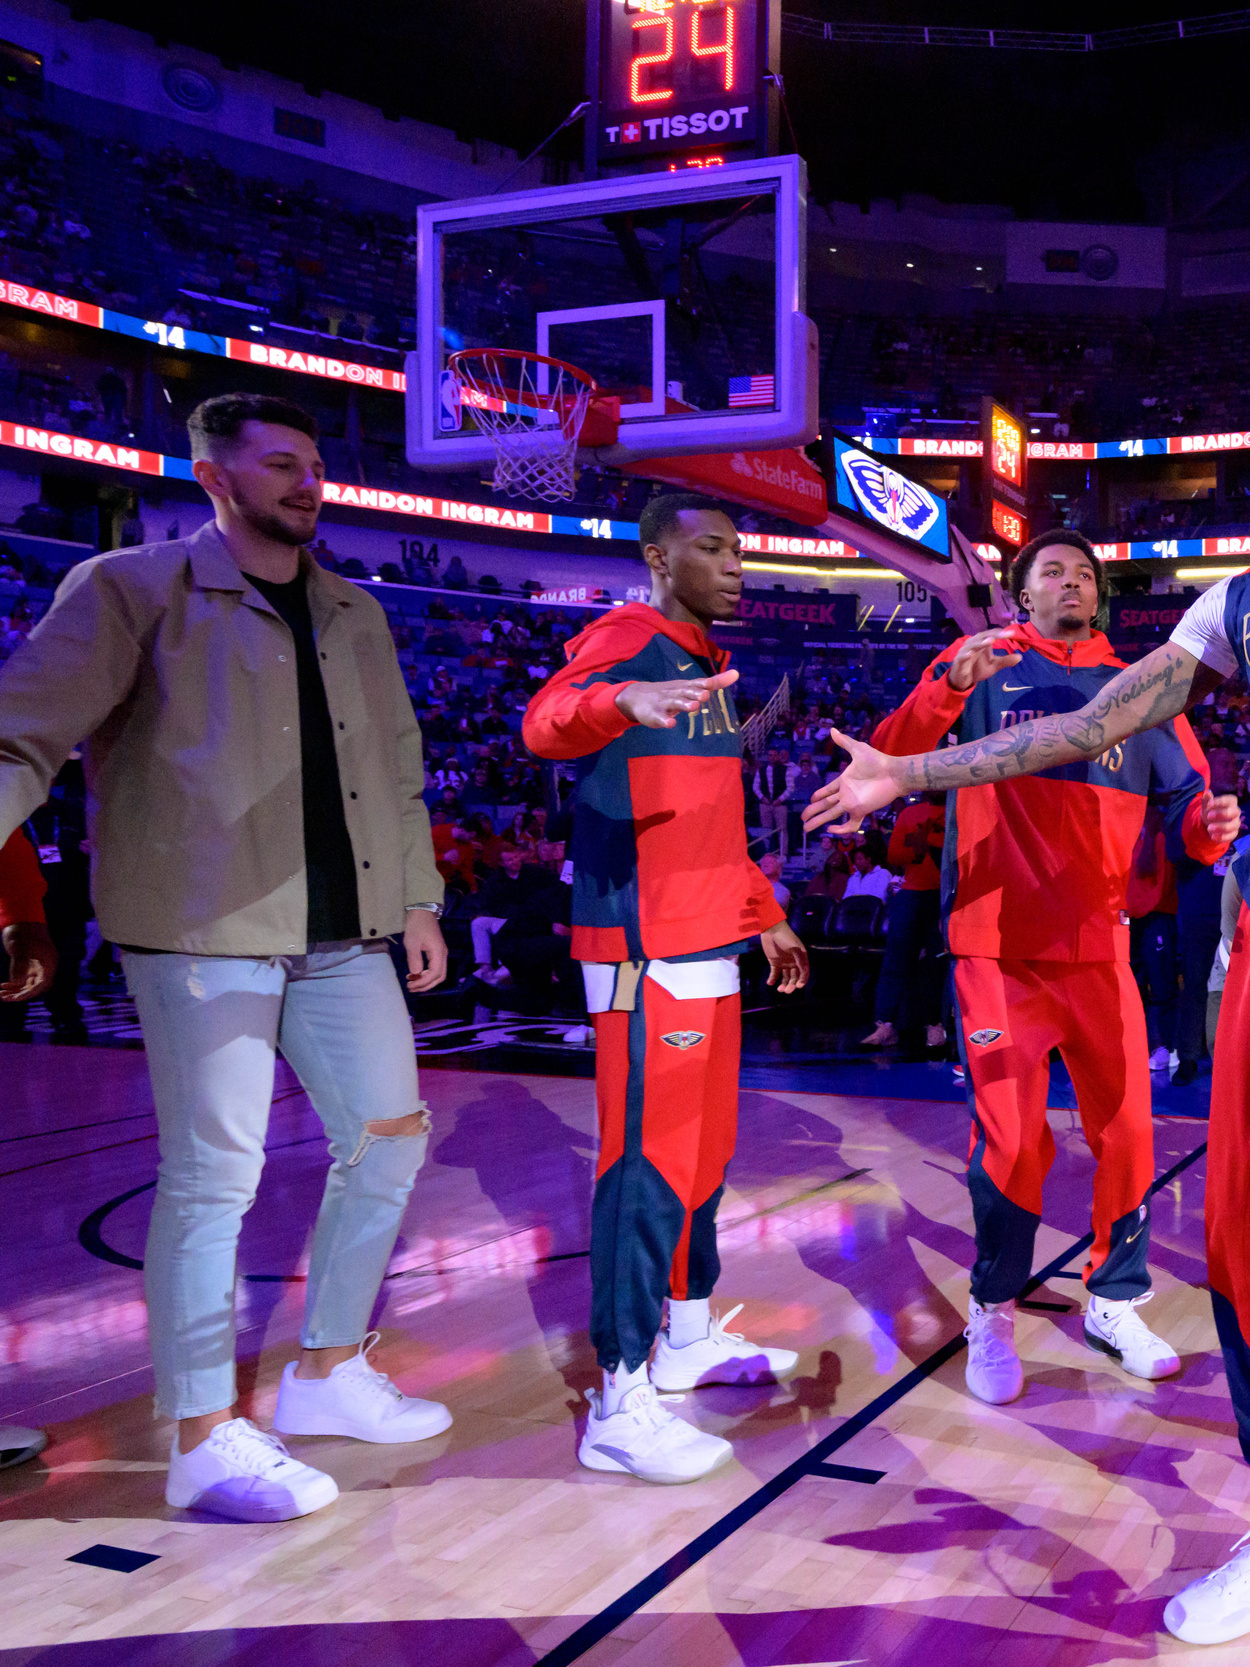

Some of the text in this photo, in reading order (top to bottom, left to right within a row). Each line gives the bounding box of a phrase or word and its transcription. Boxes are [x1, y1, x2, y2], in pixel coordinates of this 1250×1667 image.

[631, 5, 734, 103] 24
[643, 105, 750, 141] TISSOT
[143, 321, 186, 350] #14
[250, 343, 384, 387] BRANDON
[14, 426, 140, 469] INGRAM
[913, 438, 984, 455] BRAND
[1027, 442, 1084, 458] GRAM
[1118, 439, 1145, 458] #14
[322, 482, 534, 530] RANDON INGRAM
[768, 536, 844, 556] INGRAM
[895, 581, 927, 604] 105
[735, 598, 836, 625] EATGEEK
[1119, 608, 1188, 629] SEATGE
